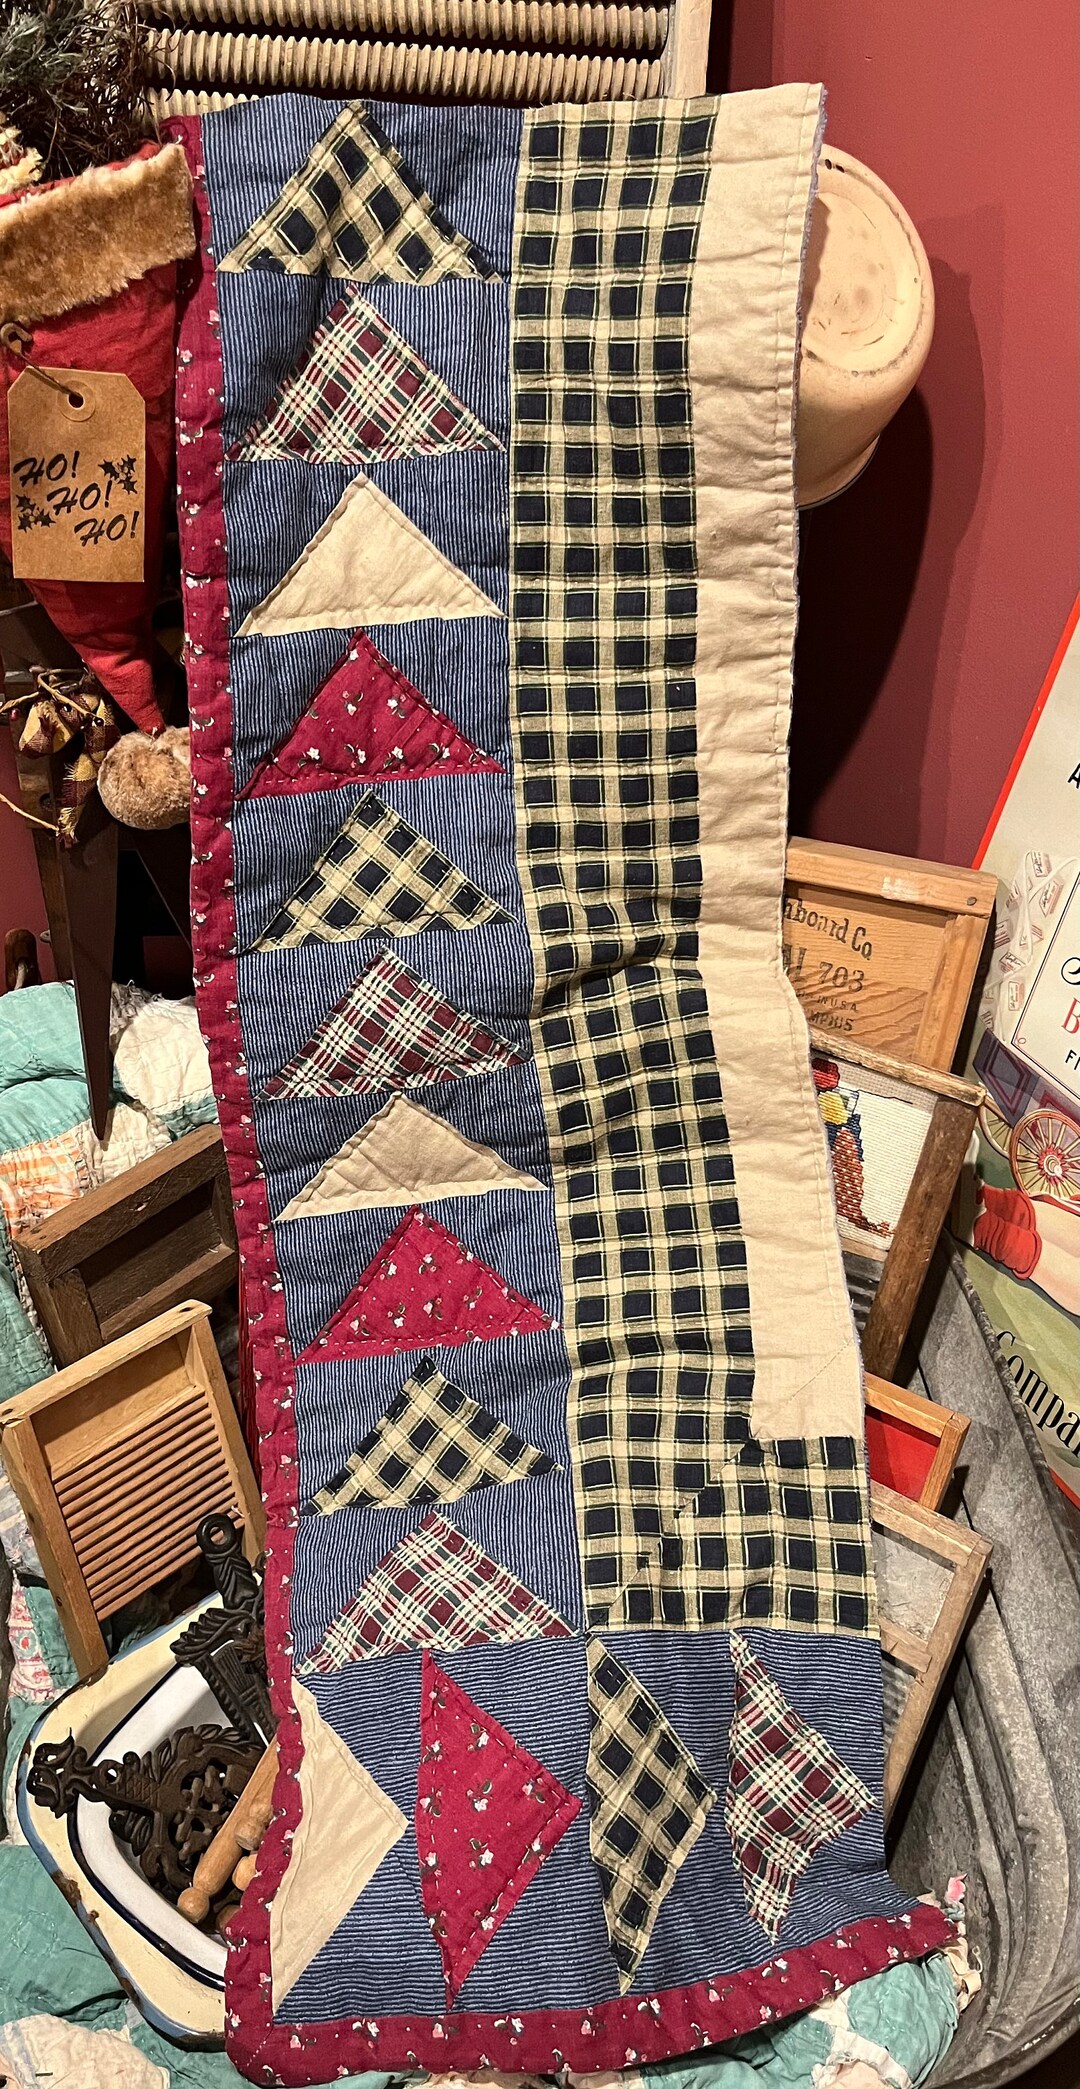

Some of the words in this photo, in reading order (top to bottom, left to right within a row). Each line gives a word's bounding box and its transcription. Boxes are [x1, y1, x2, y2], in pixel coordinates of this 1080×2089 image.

[13, 450, 80, 488] HO!
[46, 480, 113, 516] HO!
[73, 510, 140, 547] HO!
[819, 961, 865, 993] 703
[996, 1331, 1080, 1458] Compa
